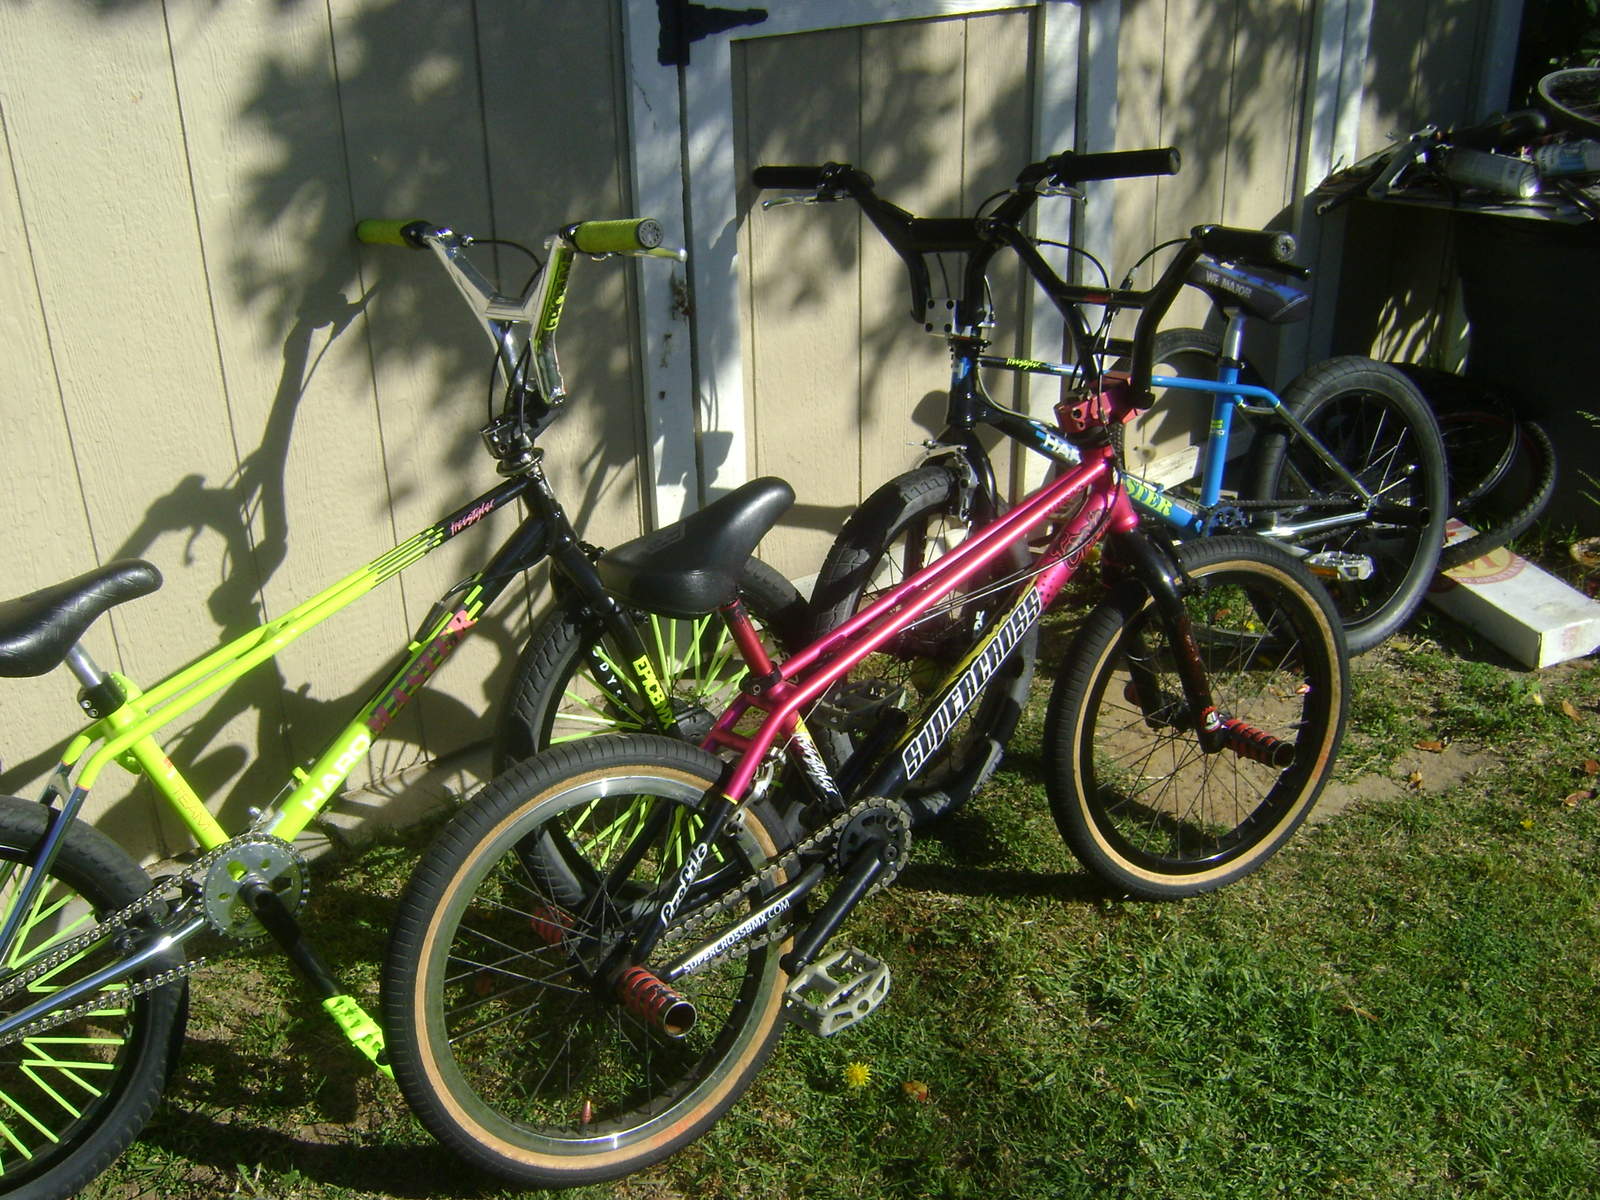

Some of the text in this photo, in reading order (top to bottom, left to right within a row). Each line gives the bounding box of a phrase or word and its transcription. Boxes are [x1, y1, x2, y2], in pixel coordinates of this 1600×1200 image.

[1043, 433, 1080, 464] HAR
[903, 588, 1042, 780] SUPERCROSS
[302, 732, 371, 810] HARO
[660, 843, 708, 927] Profile
[682, 900, 791, 974] SUPERCROSSBMX.COM
